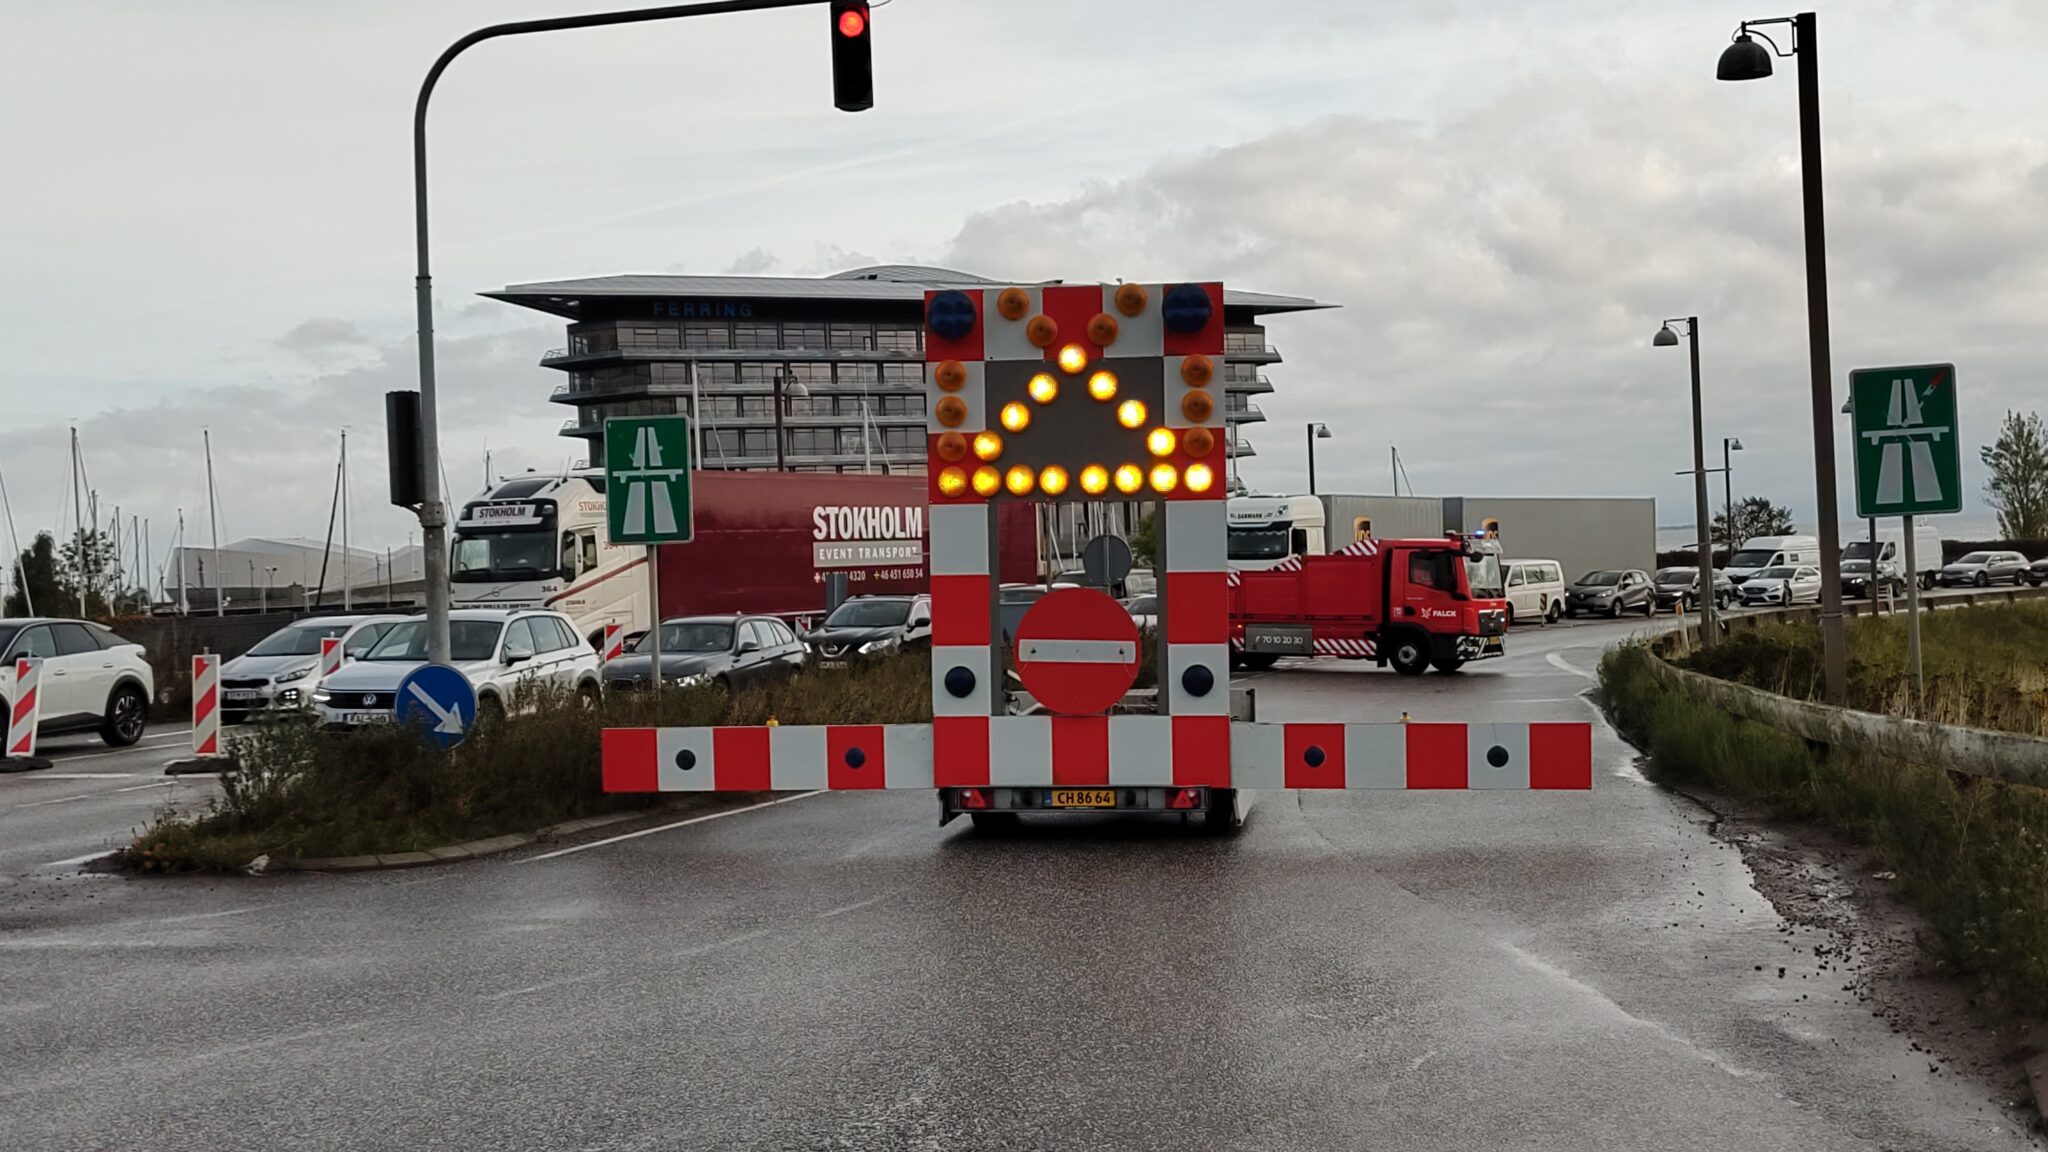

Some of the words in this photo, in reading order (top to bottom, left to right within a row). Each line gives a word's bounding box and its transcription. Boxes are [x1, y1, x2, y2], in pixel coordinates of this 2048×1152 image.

[653, 302, 752, 317] FERRING
[479, 506, 526, 519] STOKHOLM
[813, 505, 923, 540] STOKHOLM
[820, 547, 853, 560] EVENT
[858, 545, 918, 559] TRANSPORT
[849, 570, 866, 581] 4320
[541, 585, 557, 593] 364
[1262, 635, 1272, 644] 70
[1273, 635, 1281, 644] 10
[1282, 636, 1292, 645] 20
[1293, 636, 1303, 645] 30
[1057, 791, 1074, 804] CH
[1077, 791, 1092, 804] 86
[1095, 791, 1110, 804] 64
